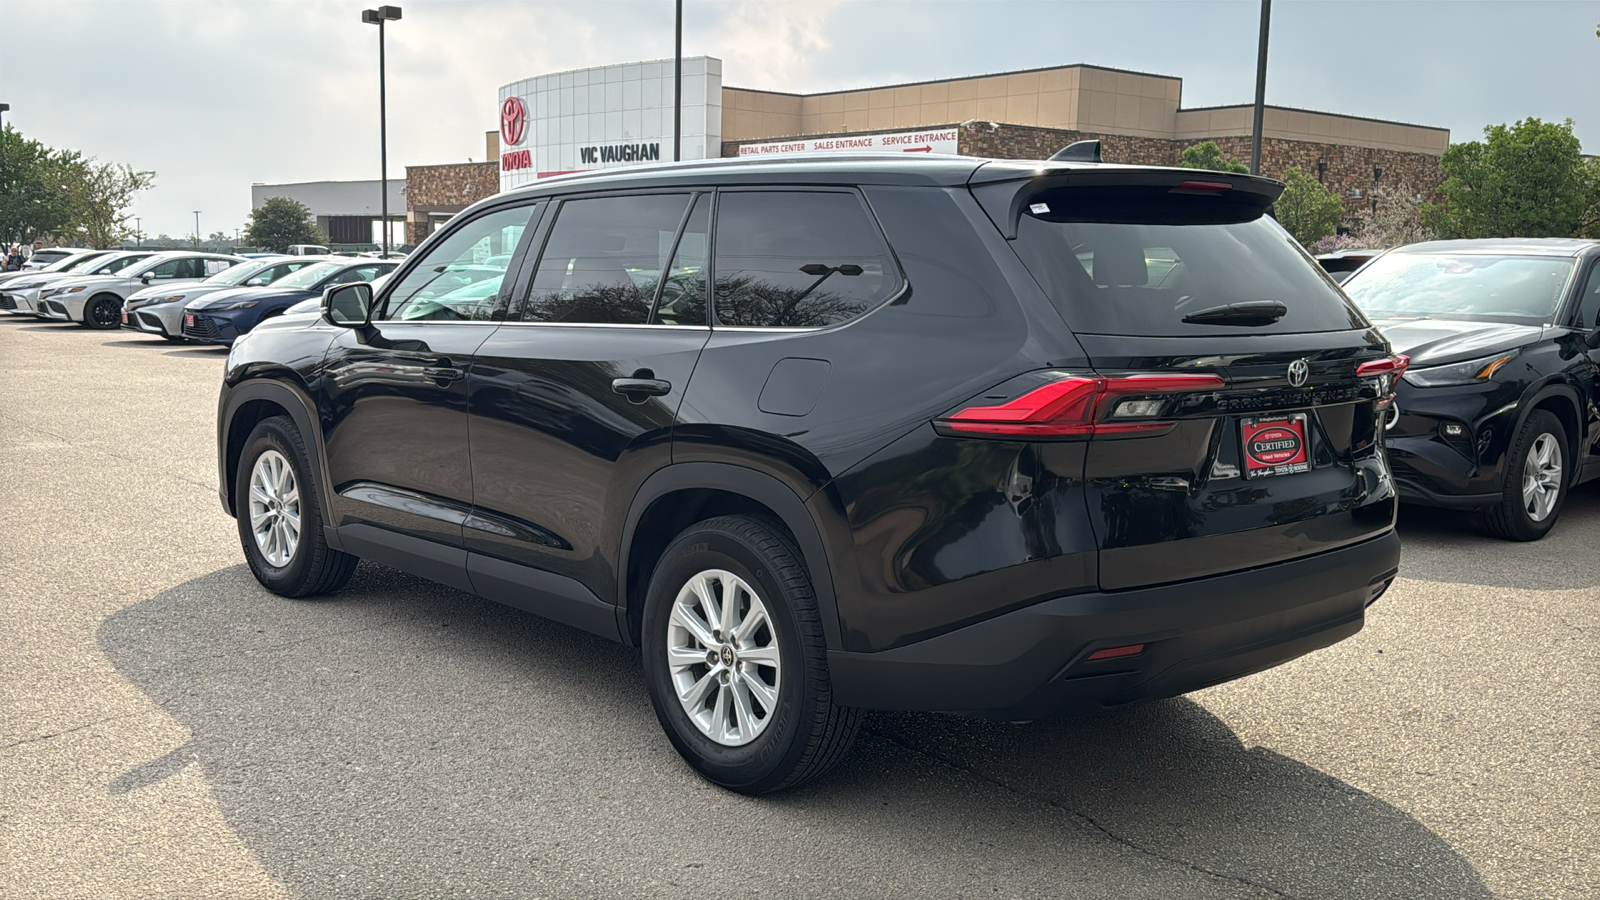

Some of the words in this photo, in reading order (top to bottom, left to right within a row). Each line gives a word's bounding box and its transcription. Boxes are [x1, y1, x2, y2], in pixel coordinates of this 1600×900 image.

[814, 141, 834, 150] SALES
[835, 138, 873, 149] ENTRANCE
[882, 135, 912, 146] SERVICE
[914, 131, 956, 143] ENTRANCE
[580, 147, 598, 164] VIC
[600, 143, 660, 163] VAUGHAN
[740, 146, 759, 155] RETAIL
[761, 145, 779, 154] PARTS
[781, 143, 805, 153] CENTER
[502, 149, 532, 171] TOYOTA
[1216, 397, 1272, 410] GRAND
